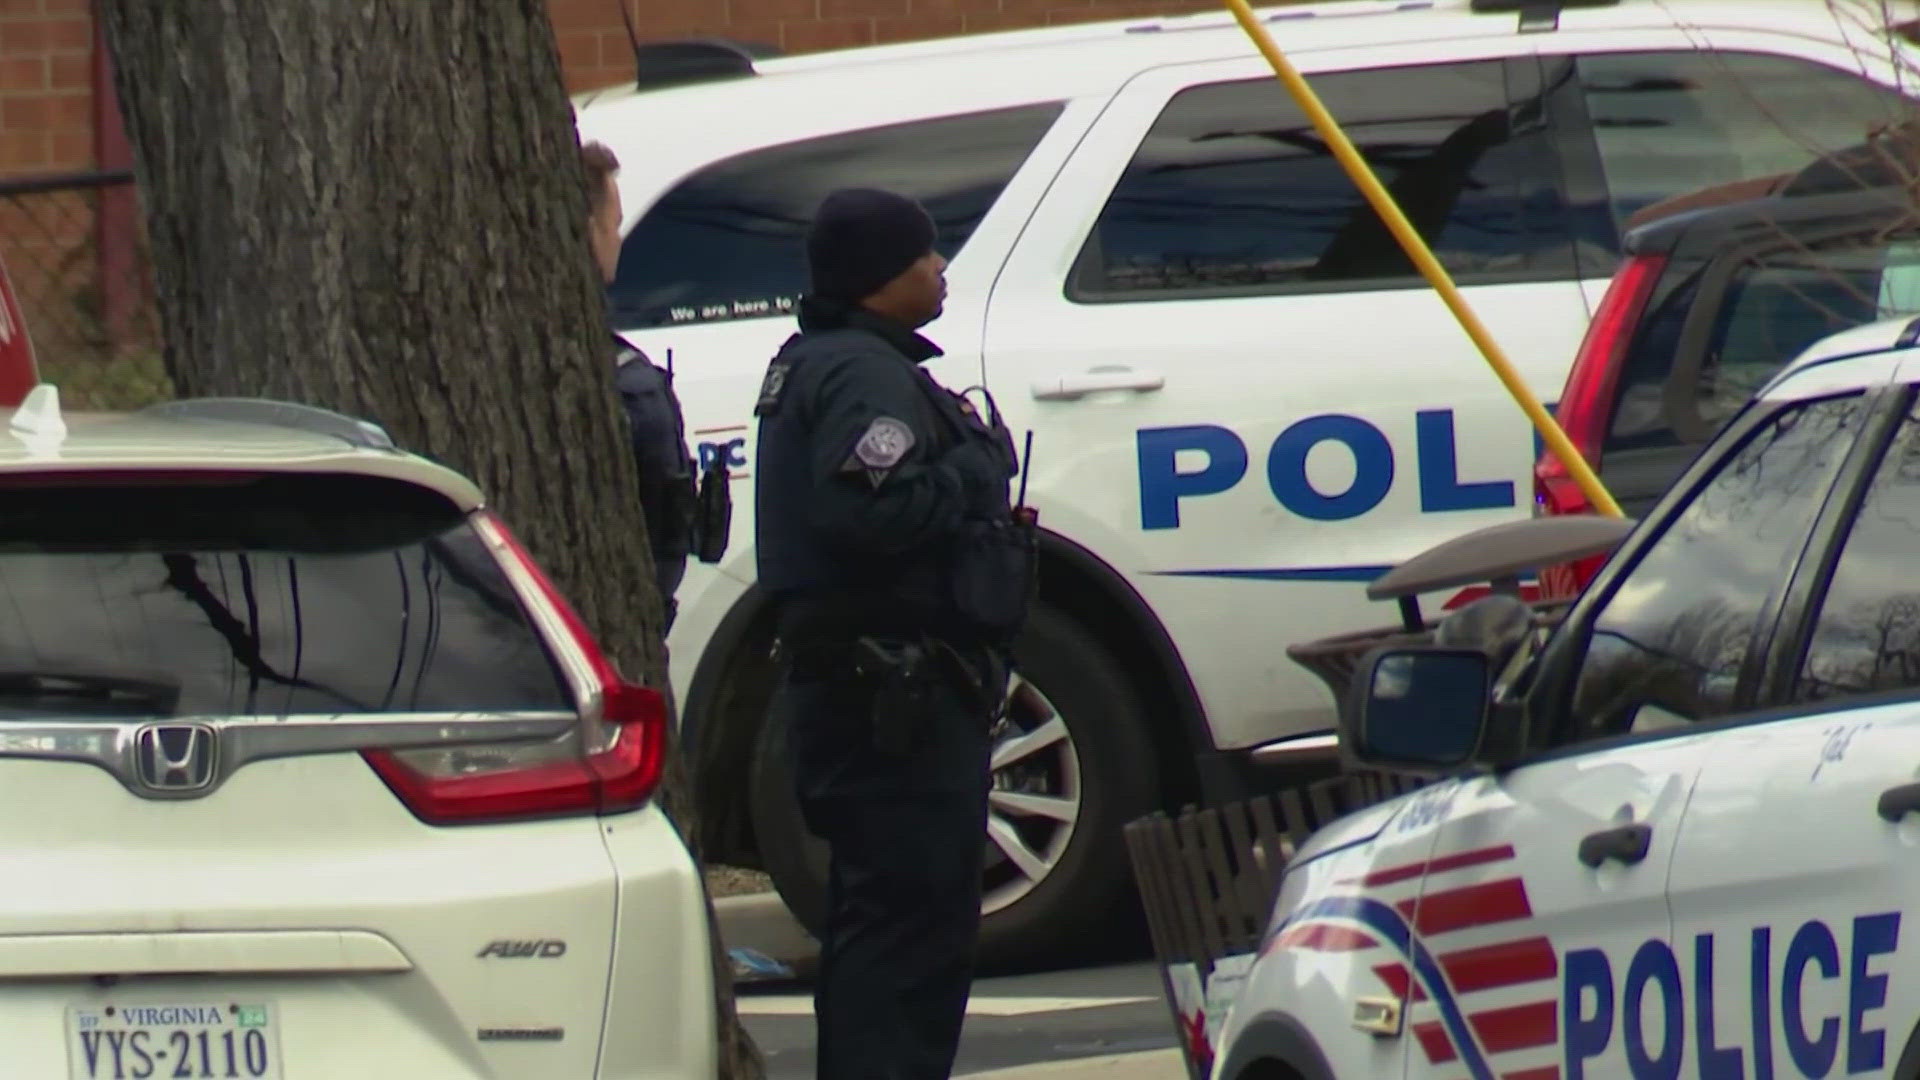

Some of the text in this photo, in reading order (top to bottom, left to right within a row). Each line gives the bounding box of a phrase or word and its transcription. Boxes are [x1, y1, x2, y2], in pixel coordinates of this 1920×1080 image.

[670, 307, 696, 321] We
[701, 305, 727, 318] are
[733, 300, 769, 313] here
[775, 296, 792, 309] to
[476, 939, 567, 958] AWD
[1564, 911, 1902, 1080] POLICE
[122, 1006, 222, 1026] VIRGINIA
[79, 1028, 267, 1080] VYS-2110
